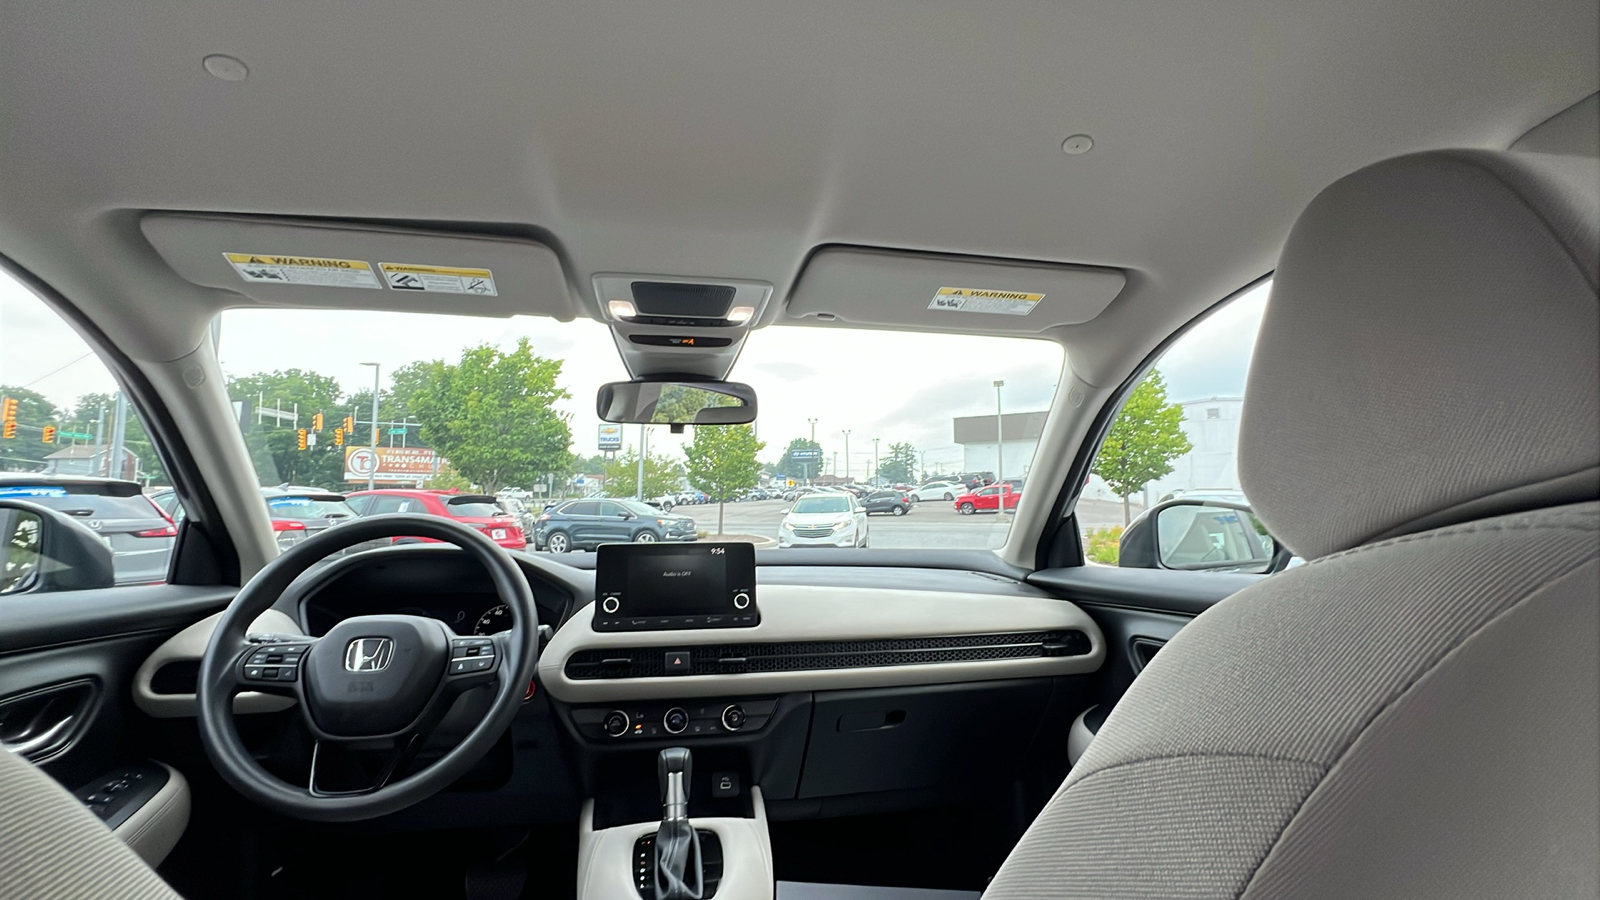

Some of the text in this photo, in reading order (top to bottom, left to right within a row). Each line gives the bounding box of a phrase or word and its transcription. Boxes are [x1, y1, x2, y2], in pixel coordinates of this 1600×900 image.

[270, 257, 351, 268] WARNING
[970, 290, 1028, 300] WARNING
[711, 547, 725, 555] 9:54
